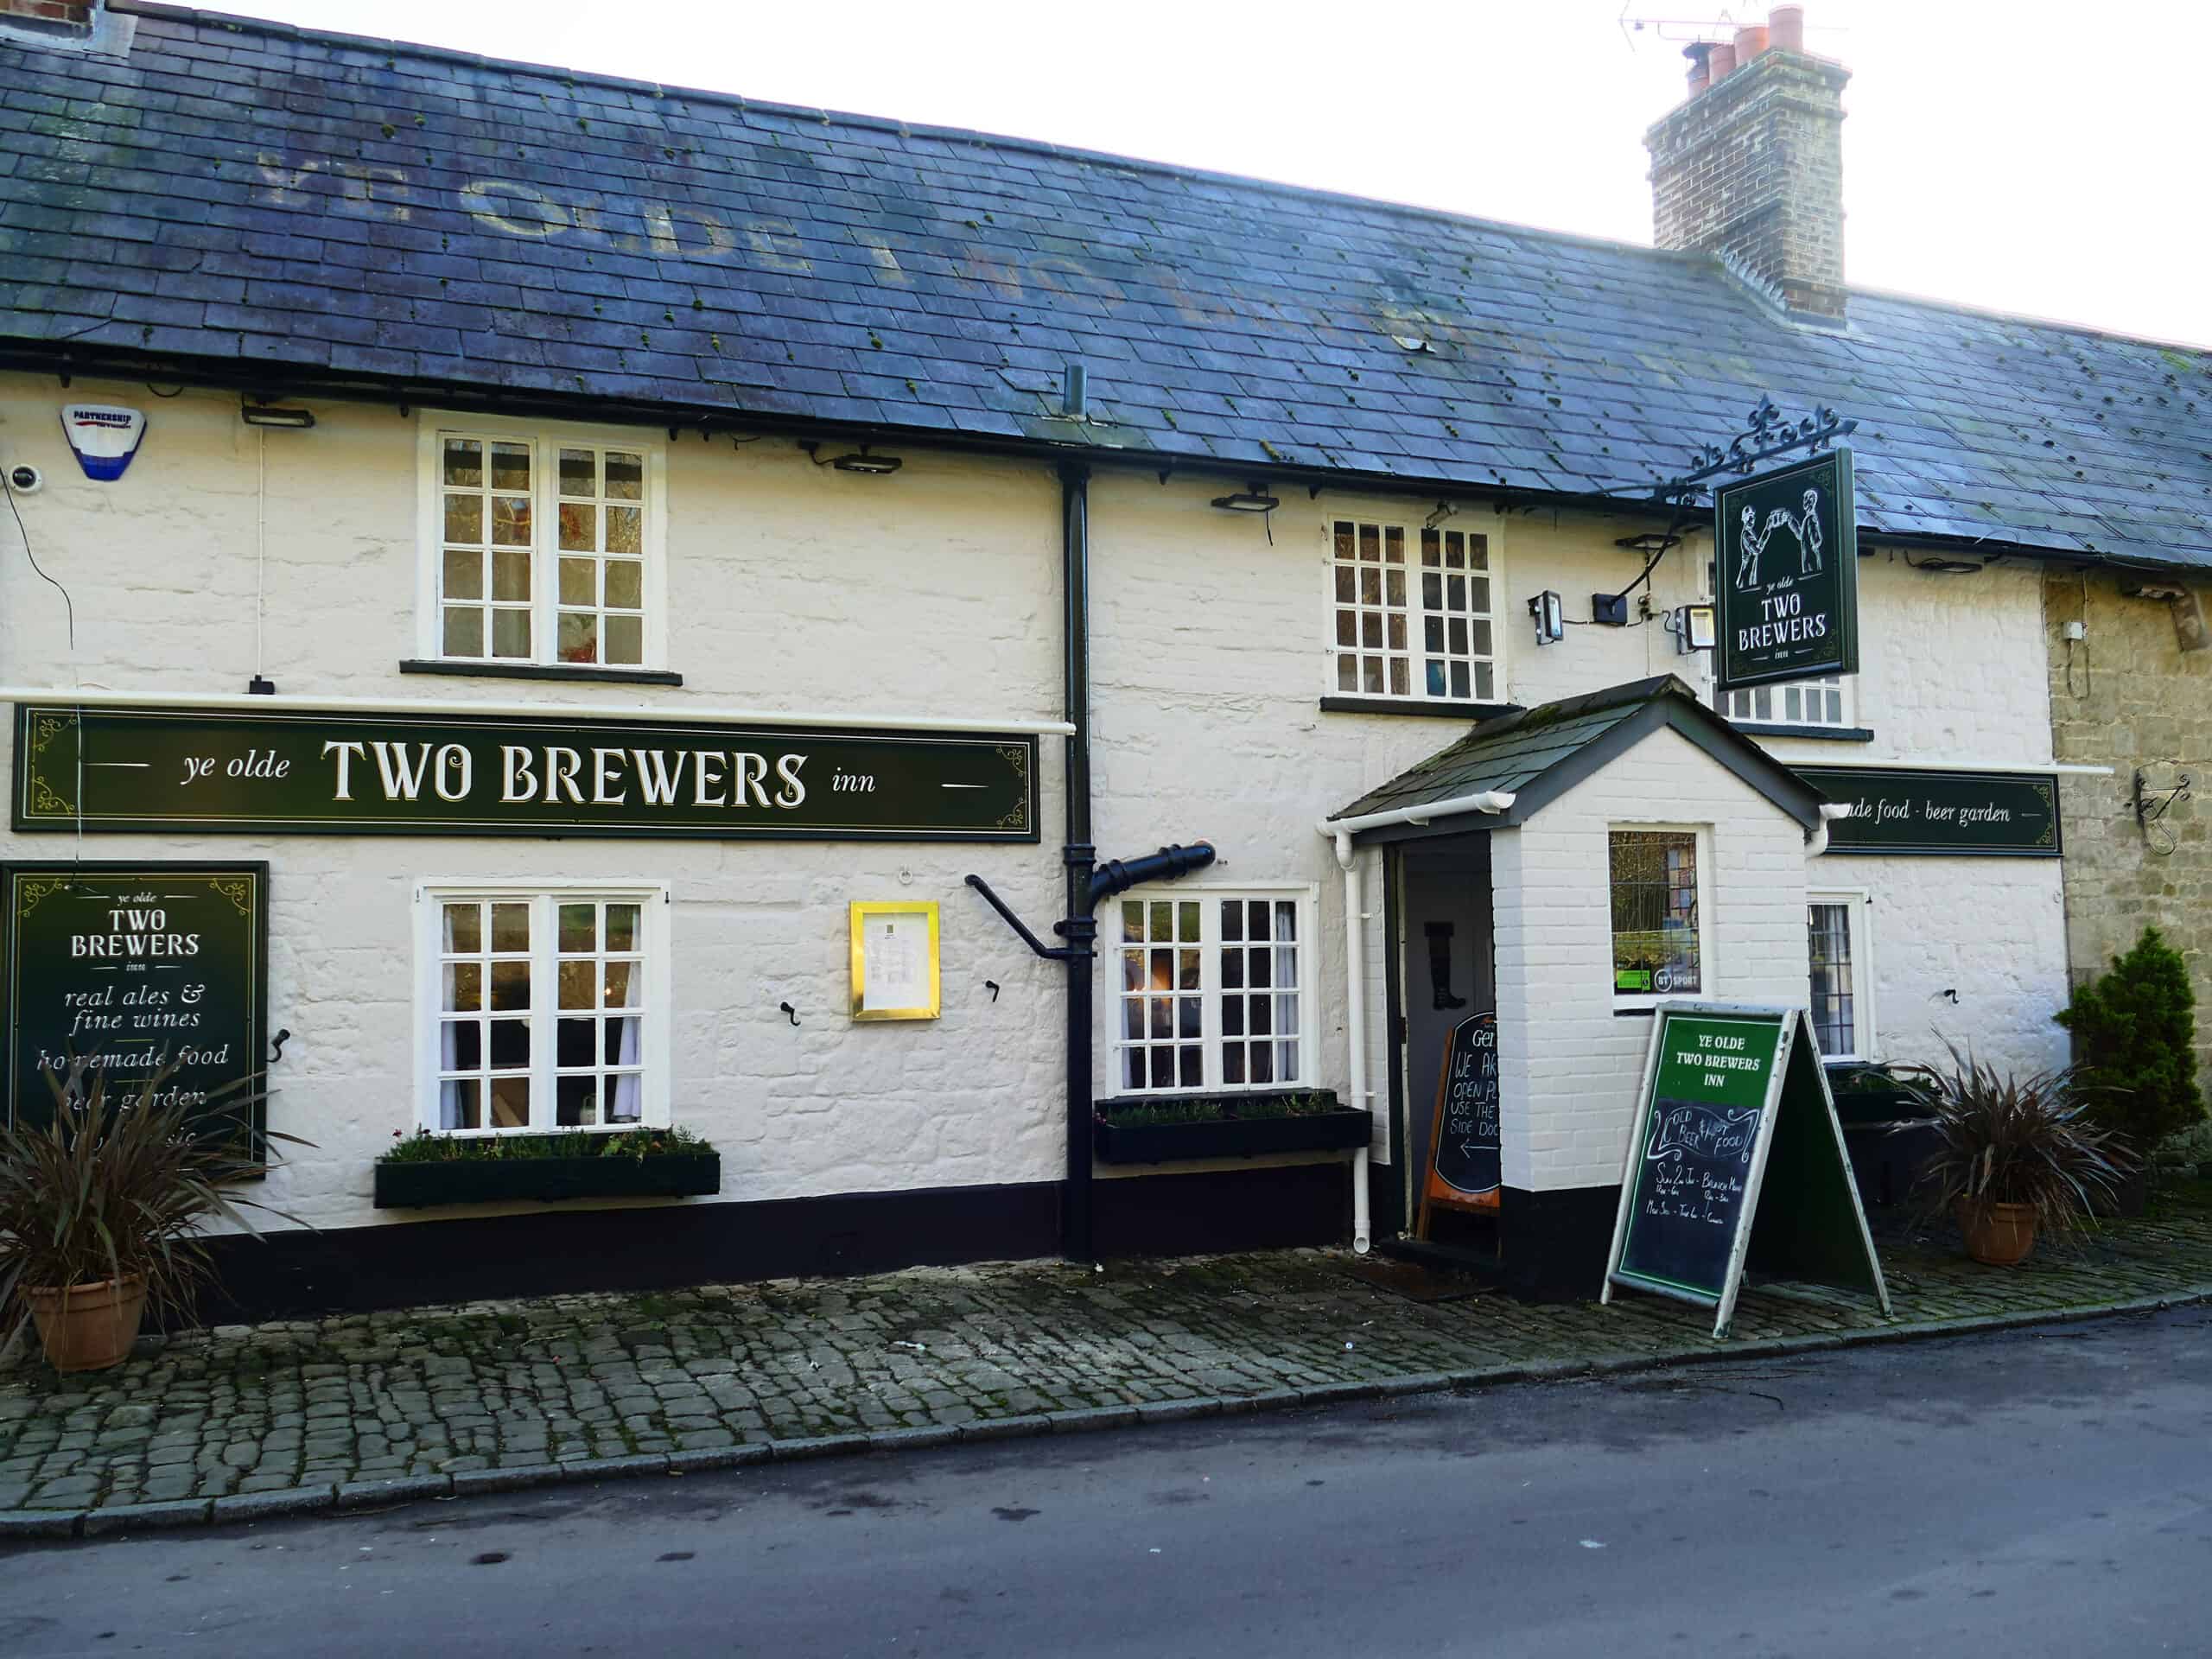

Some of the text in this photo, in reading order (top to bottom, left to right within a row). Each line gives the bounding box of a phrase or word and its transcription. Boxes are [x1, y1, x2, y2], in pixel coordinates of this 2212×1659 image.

[73, 410, 132, 423] PARTNERSHIP
[1761, 594, 1801, 621] TWO
[1738, 613, 1827, 652] BREWERS
[1774, 648, 1789, 659] inn
[180, 740, 875, 809] ye olde TWO BREWERS inn
[1874, 798, 1910, 825] food
[1925, 799, 1956, 821] beer
[1959, 802, 2011, 827] garden
[118, 892, 157, 906] ye olde
[108, 909, 167, 932] TWO
[71, 933, 201, 957] BREWERS
[126, 961, 146, 972] inn
[1658, 976, 1669, 985] BT
[1673, 976, 1698, 986] SPORT
[64, 983, 207, 1007] real ales &
[68, 1007, 201, 1037] fine wines
[1699, 1034, 1745, 1051] YE OLDE
[172, 1044, 230, 1071] food
[1455, 1052, 1472, 1079] WE
[1676, 1052, 1761, 1071] TWO BREWERS
[1453, 1081, 1482, 1102] OPEN
[1704, 1074, 1726, 1087] INN
[1451, 1100, 1493, 1121] USE THE
[1450, 1119, 1472, 1135] SIDE
[1662, 1110, 1693, 1143] COLD
[1679, 1124, 1700, 1150] BEER
[1713, 1135, 1745, 1155] FOOD
